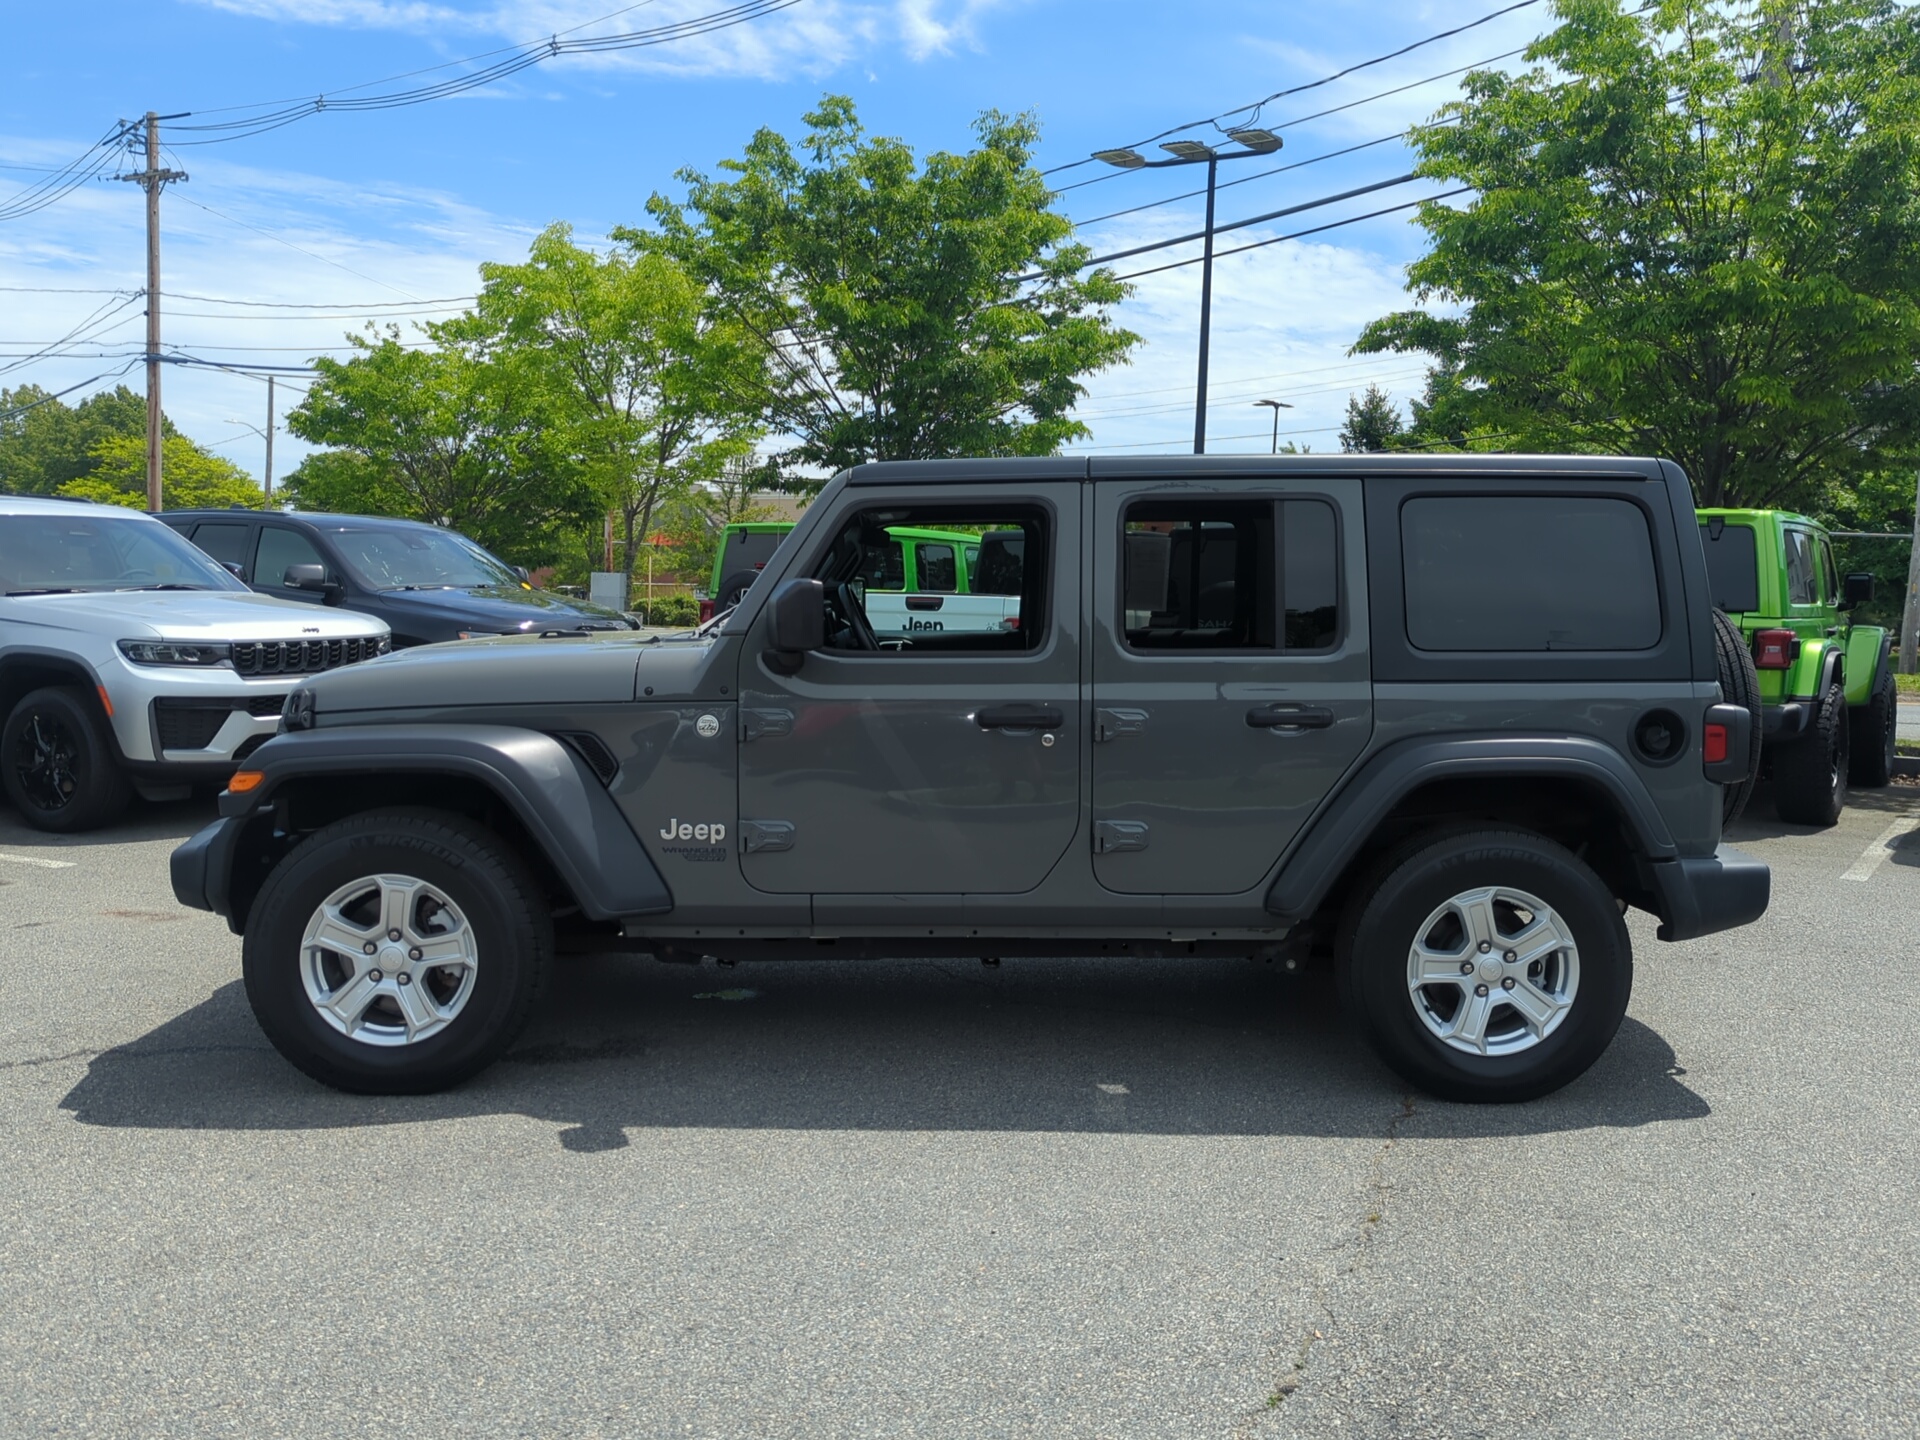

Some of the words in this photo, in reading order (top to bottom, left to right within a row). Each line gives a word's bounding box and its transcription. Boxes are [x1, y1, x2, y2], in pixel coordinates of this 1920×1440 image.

[660, 818, 725, 844] Jeep
[374, 835, 465, 869] MICHELIN
[661, 846, 727, 854] WRANGLER
